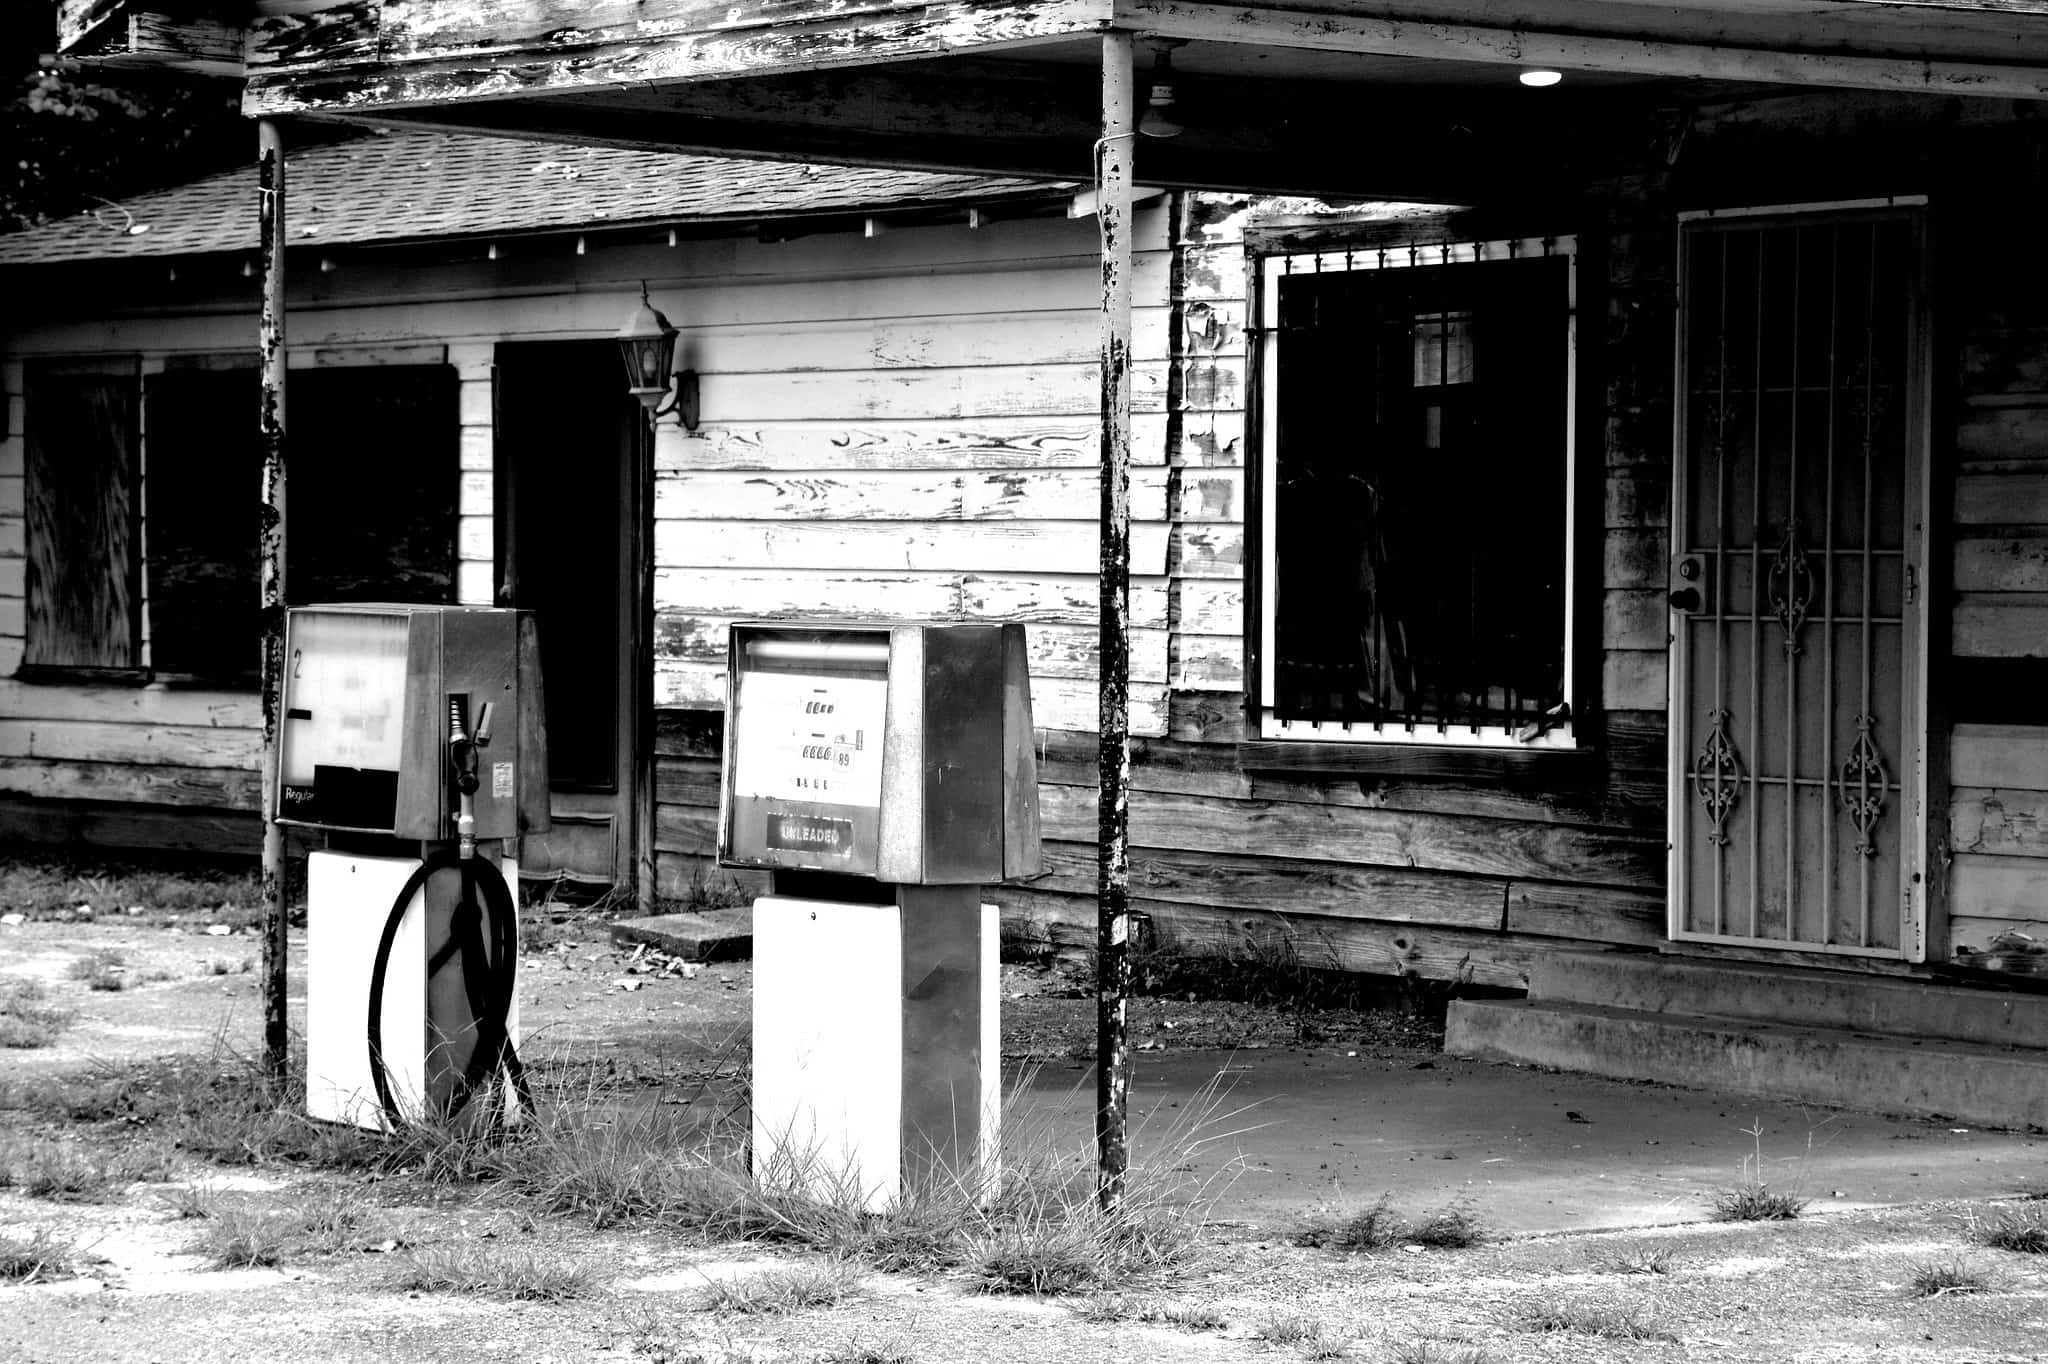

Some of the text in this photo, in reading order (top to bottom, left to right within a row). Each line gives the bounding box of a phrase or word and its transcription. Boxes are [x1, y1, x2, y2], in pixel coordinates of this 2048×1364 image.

[294, 648, 302, 679] 2
[838, 753, 850, 766] 89
[285, 787, 315, 803] Regular
[781, 826, 839, 843] UNLEADED
